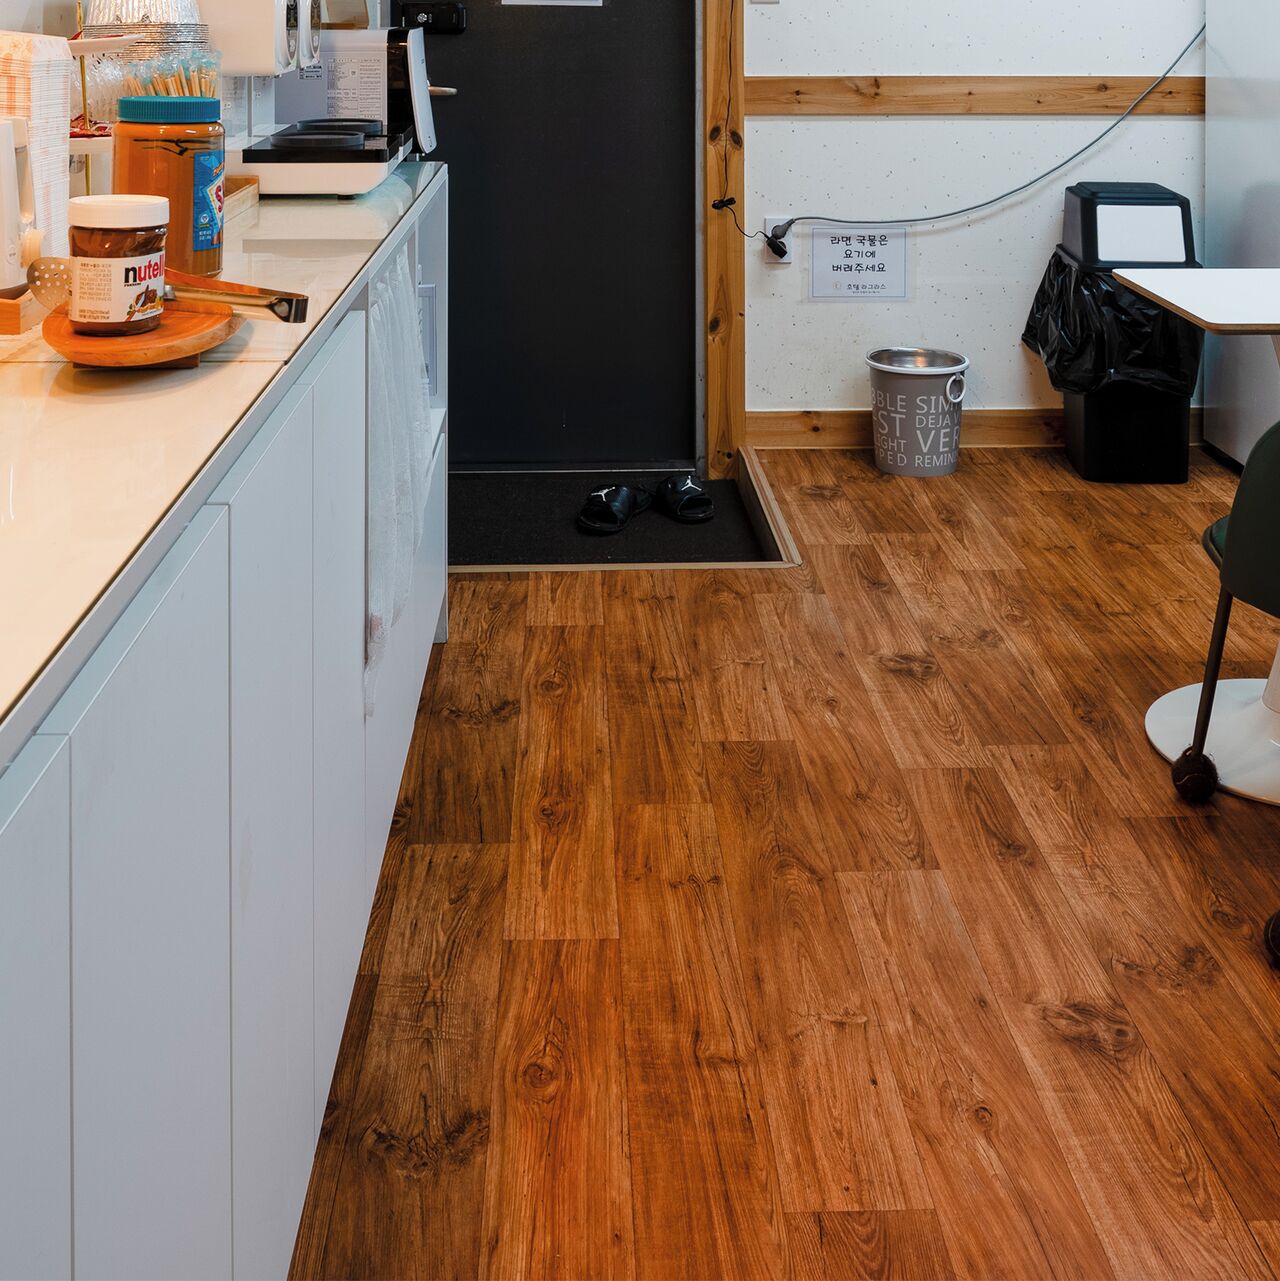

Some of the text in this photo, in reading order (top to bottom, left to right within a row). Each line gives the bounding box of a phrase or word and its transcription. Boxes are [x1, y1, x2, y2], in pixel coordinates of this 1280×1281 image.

[830, 234, 888, 247] 라면 국물은
[843, 249, 876, 258] 요기에
[832, 263, 886, 274] 버려주세요
[915, 414, 951, 428] DEJA
